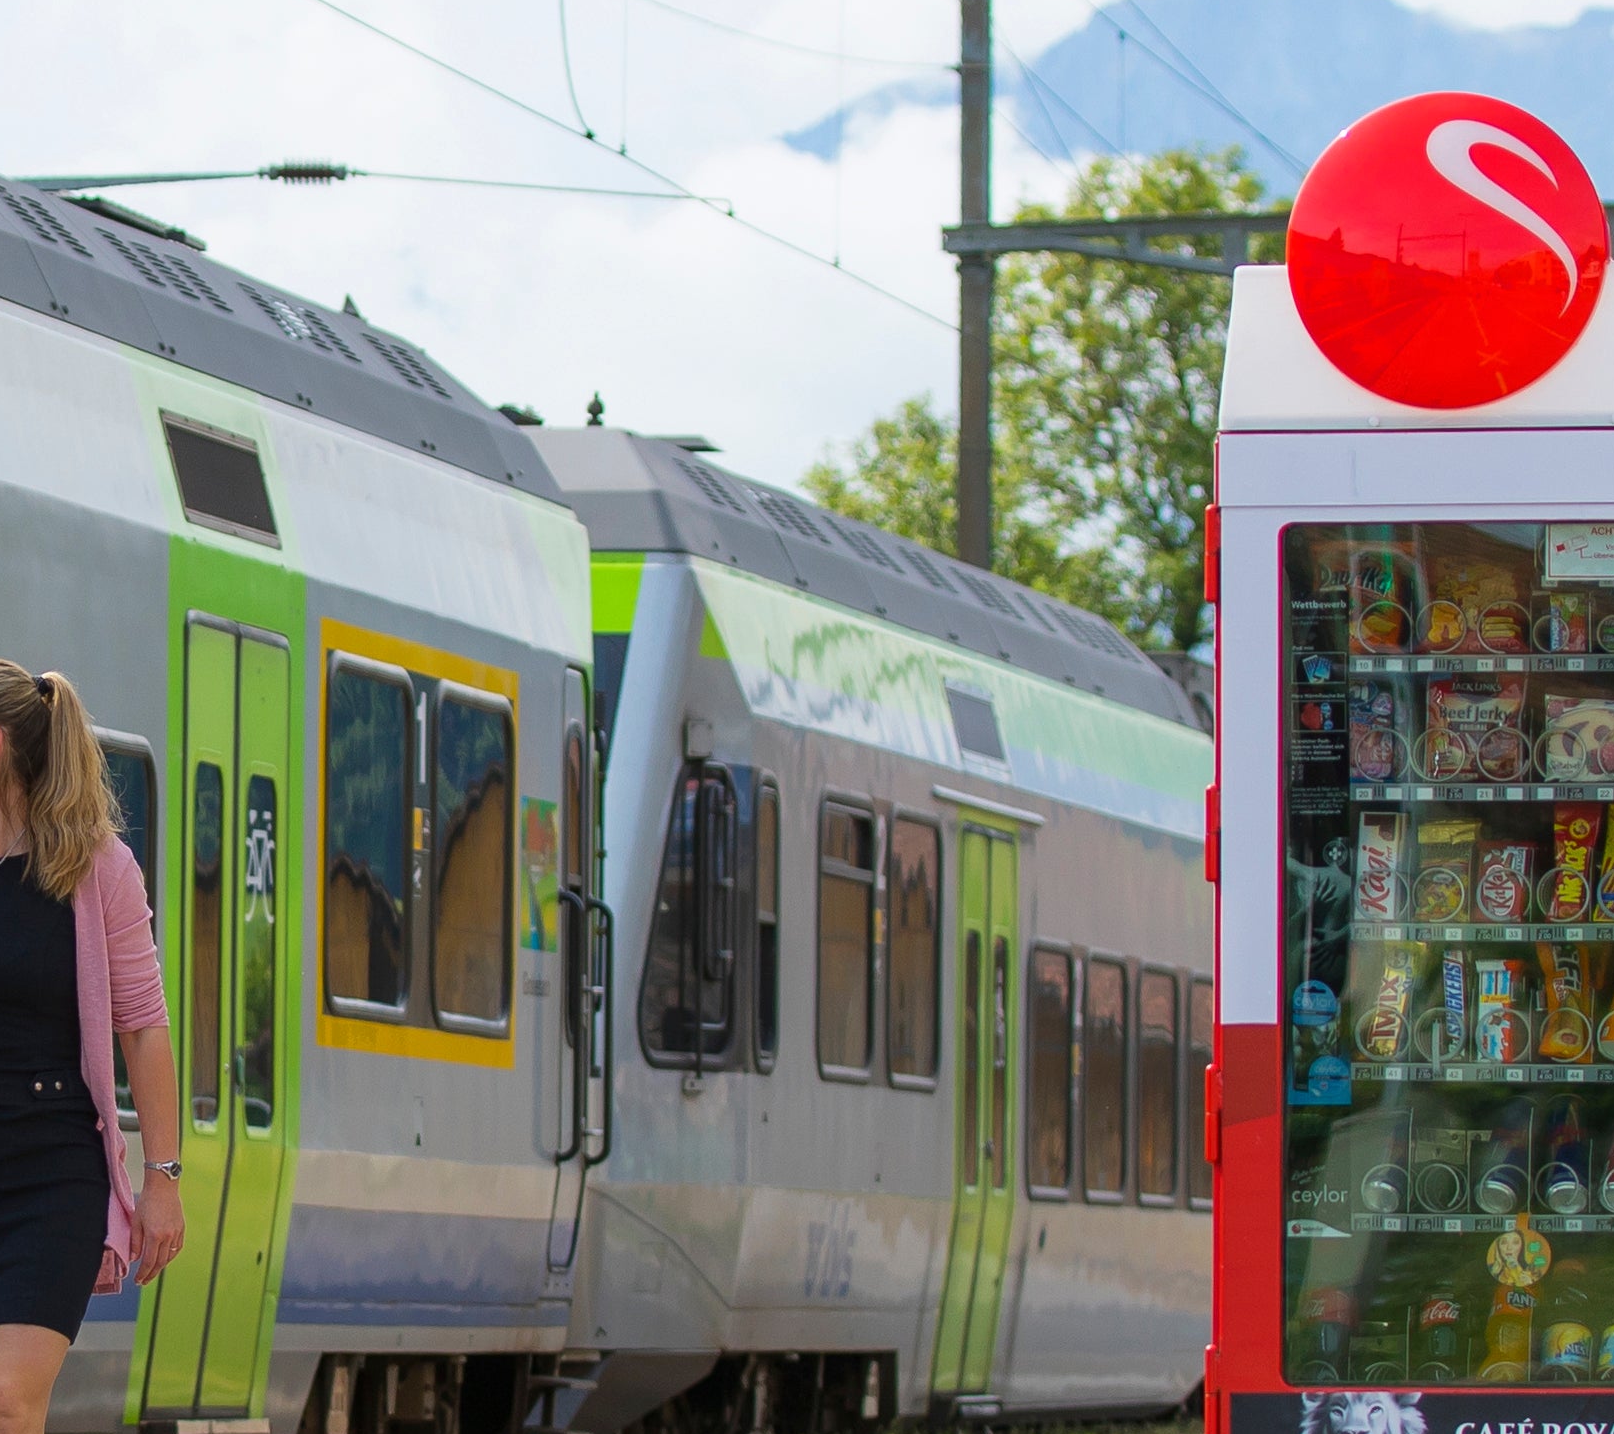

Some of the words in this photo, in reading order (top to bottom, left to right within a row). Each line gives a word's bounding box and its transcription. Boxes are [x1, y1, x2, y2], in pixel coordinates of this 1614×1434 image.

[1440, 705, 1471, 719] Beef
[1474, 706, 1514, 722] Jerky
[1291, 1183, 1348, 1207] ceylor
